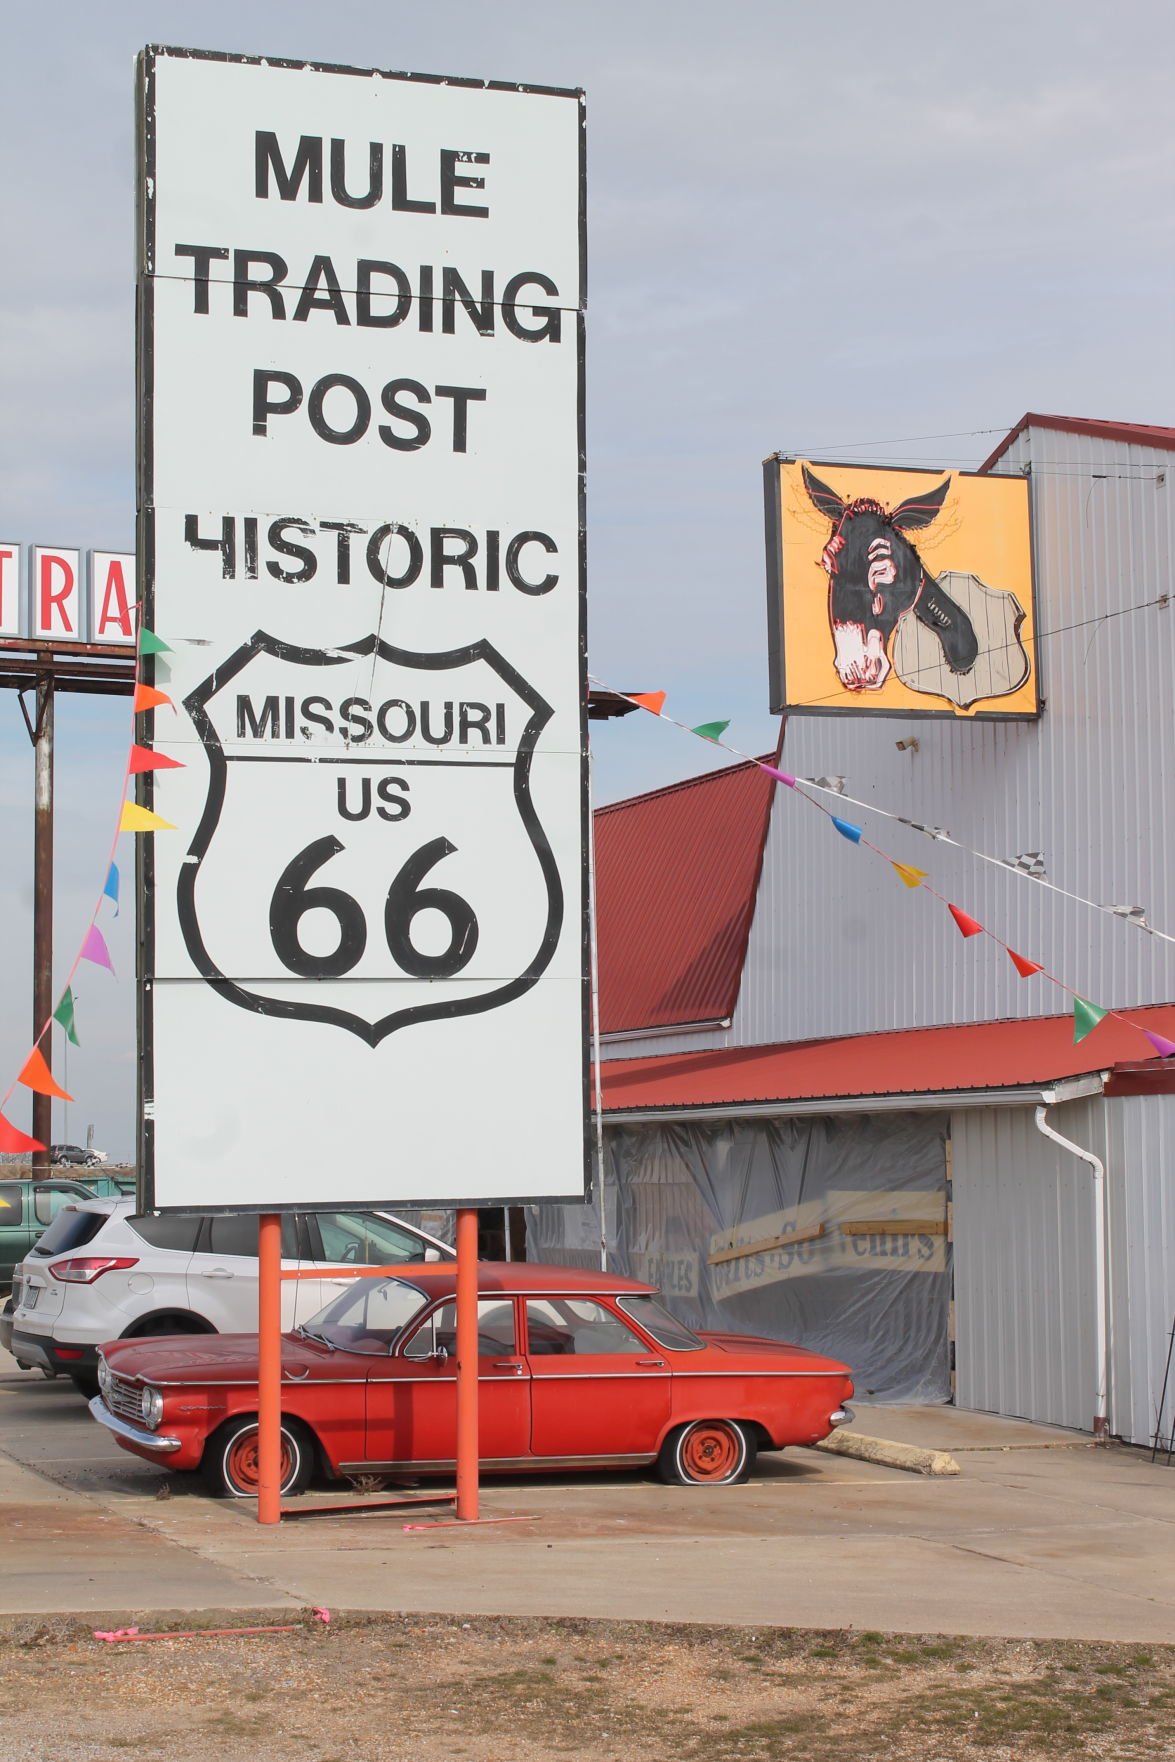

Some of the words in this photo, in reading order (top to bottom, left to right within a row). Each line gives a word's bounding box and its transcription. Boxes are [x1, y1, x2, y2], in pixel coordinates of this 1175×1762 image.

[254, 130, 490, 219] MULE
[174, 243, 562, 344] TRADING
[252, 368, 487, 454] POST
[184, 513, 560, 597] HISTORIC
[235, 694, 507, 746] MISSOURI
[336, 776, 412, 823] US
[269, 834, 480, 979] 66
